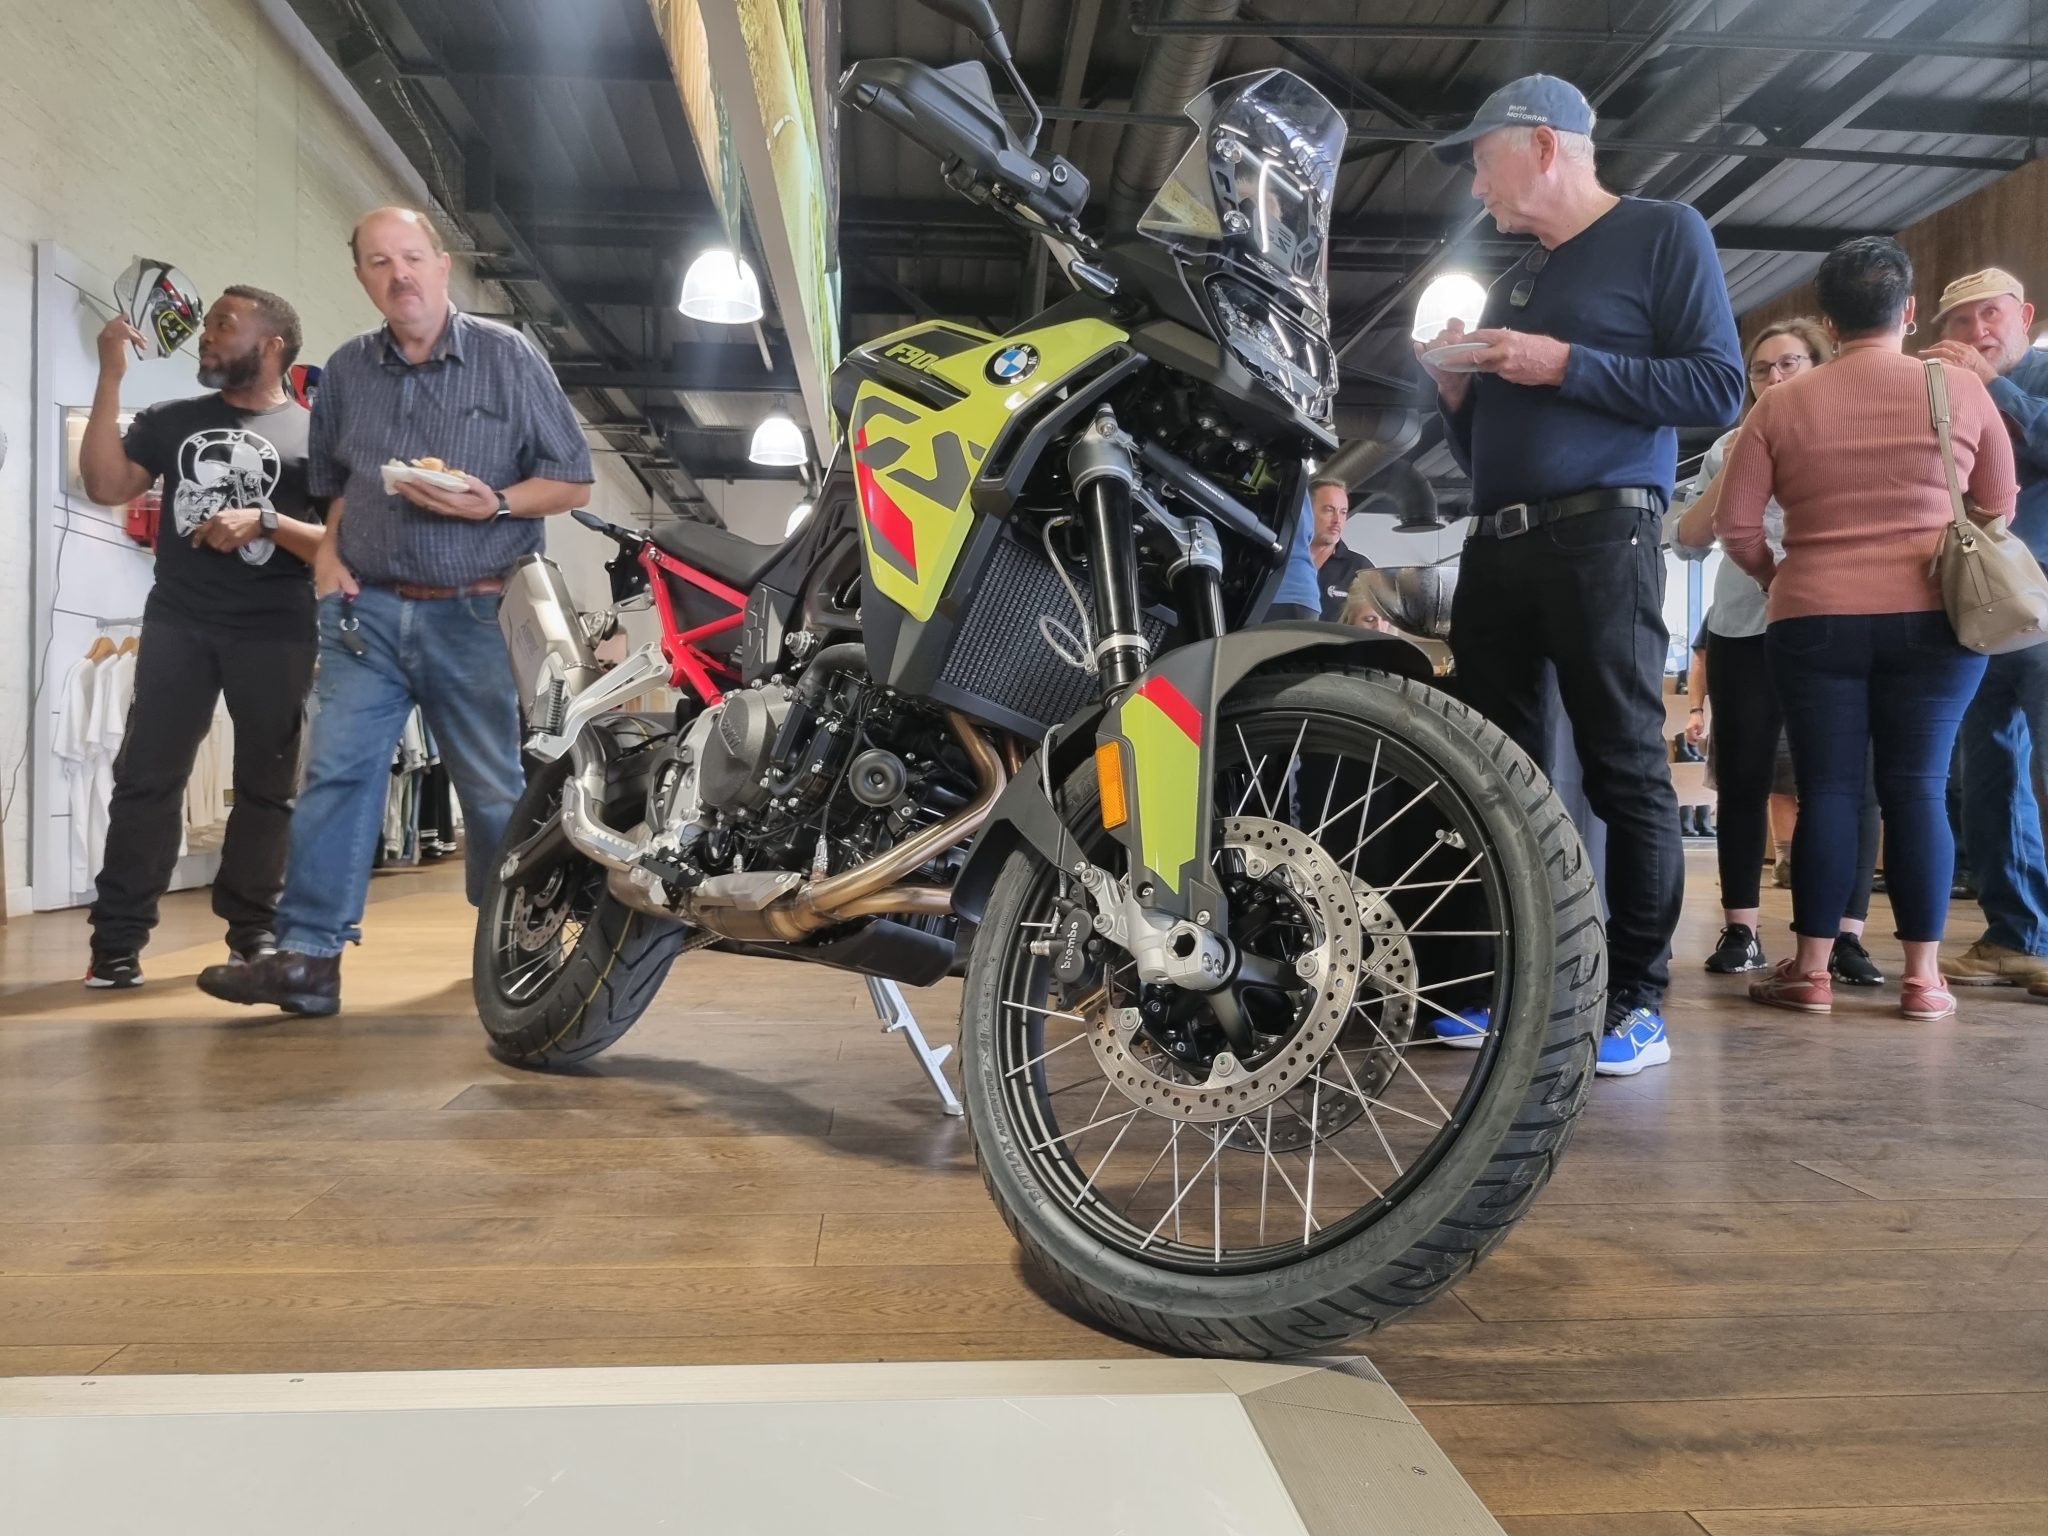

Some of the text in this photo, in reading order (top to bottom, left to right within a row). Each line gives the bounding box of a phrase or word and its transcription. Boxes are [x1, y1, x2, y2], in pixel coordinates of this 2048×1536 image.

[1506, 111, 1548, 122] MOTORRAD
[885, 343, 938, 375] F90
[188, 431, 277, 461] BMW
[1060, 921, 1079, 969] brembo
